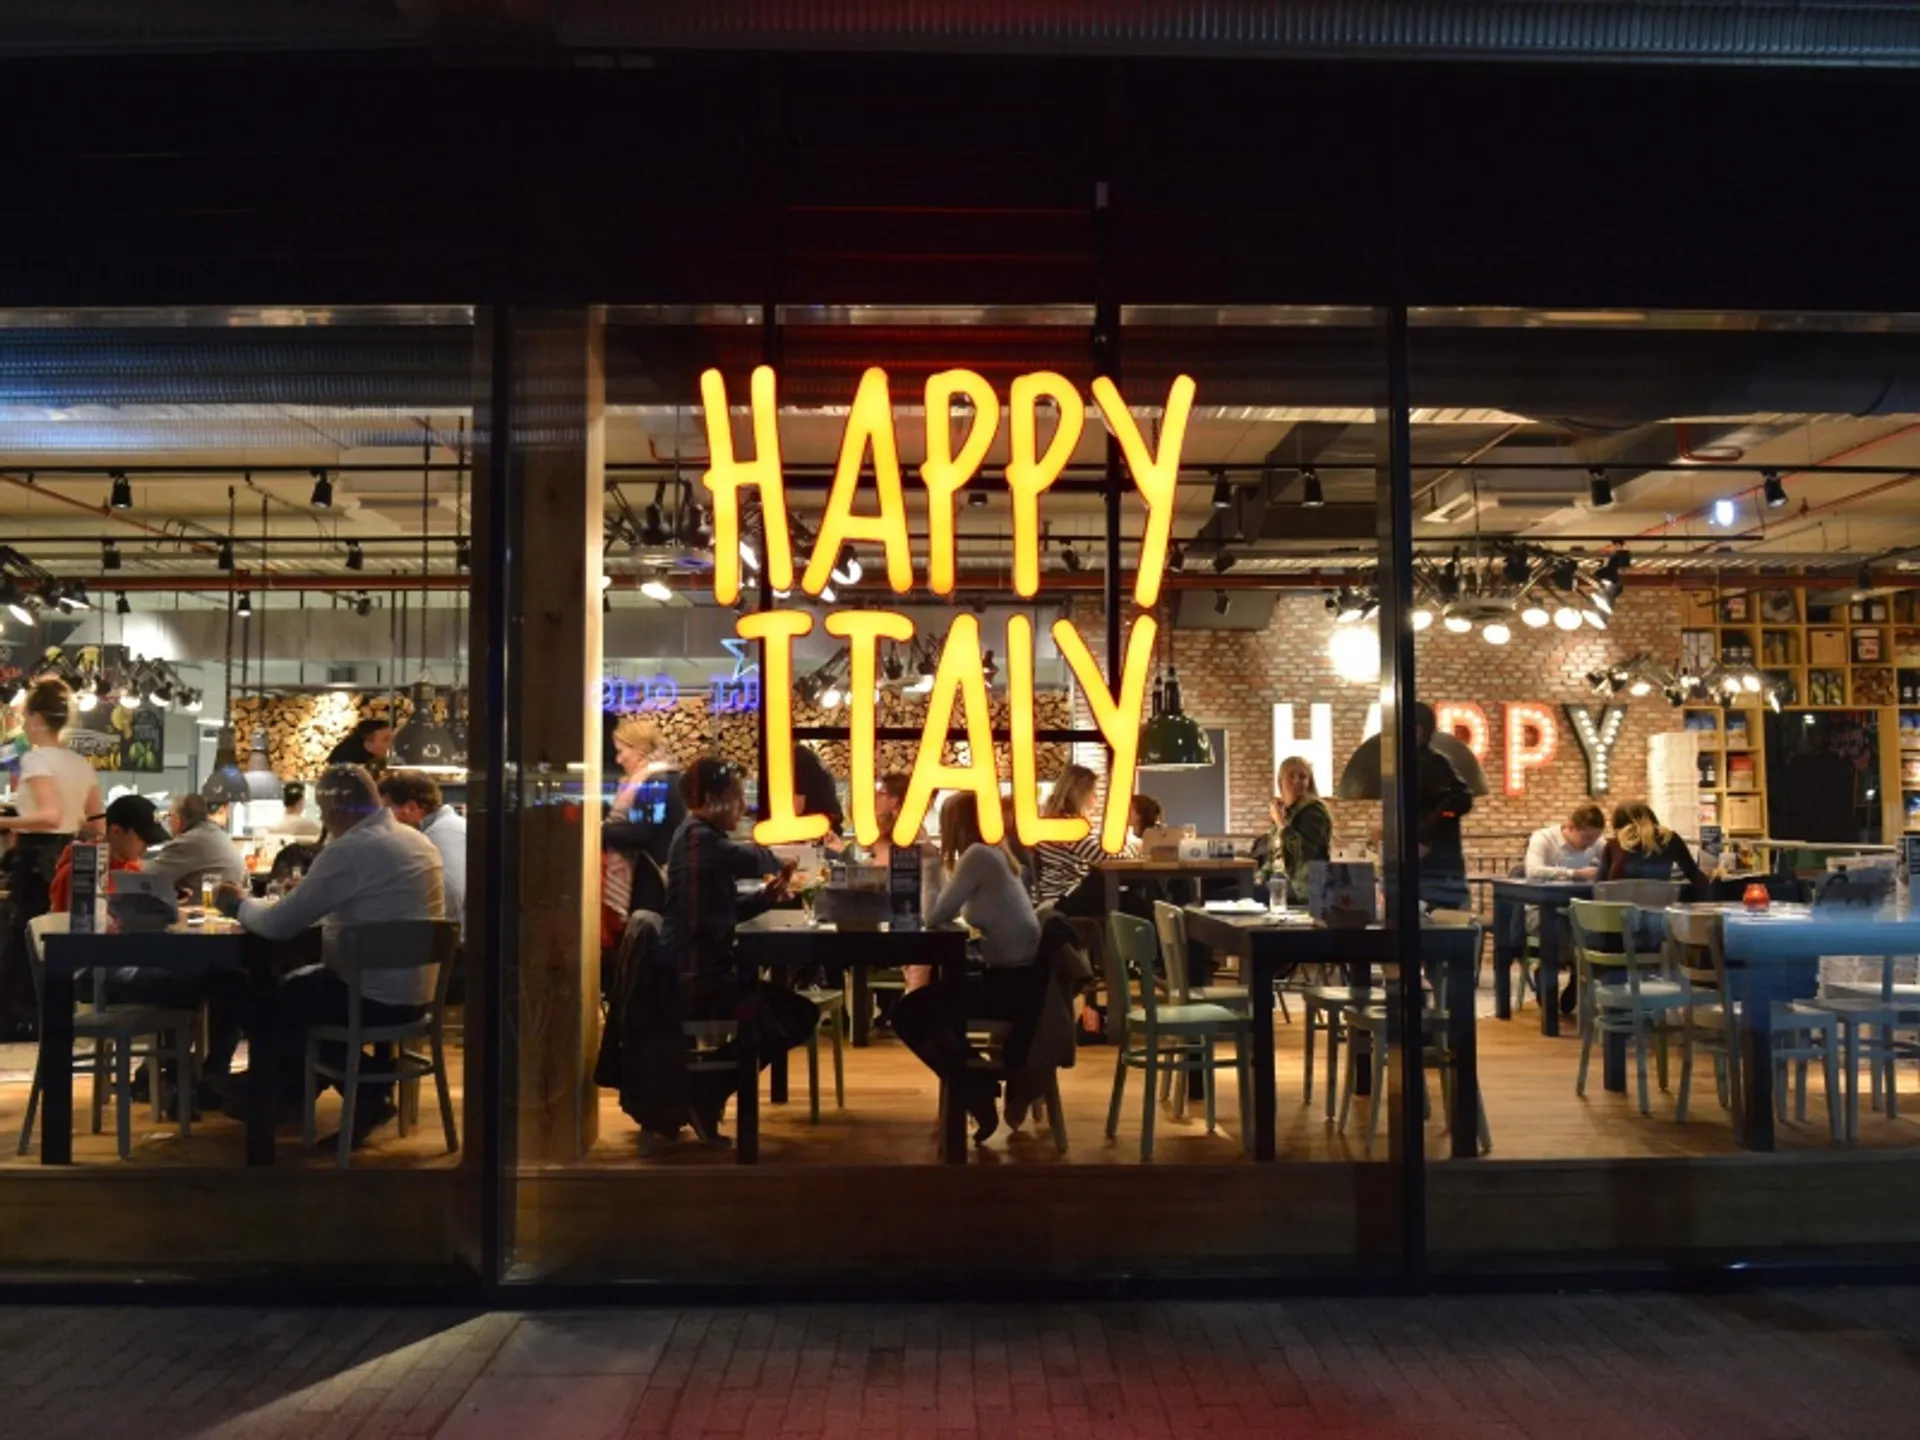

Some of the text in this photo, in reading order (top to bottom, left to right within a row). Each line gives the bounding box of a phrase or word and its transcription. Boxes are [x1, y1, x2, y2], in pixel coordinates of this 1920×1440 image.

[700, 364, 1195, 609] HAPPY
[735, 609, 1158, 854] ITALY
[1272, 702, 1628, 798] HPPY
